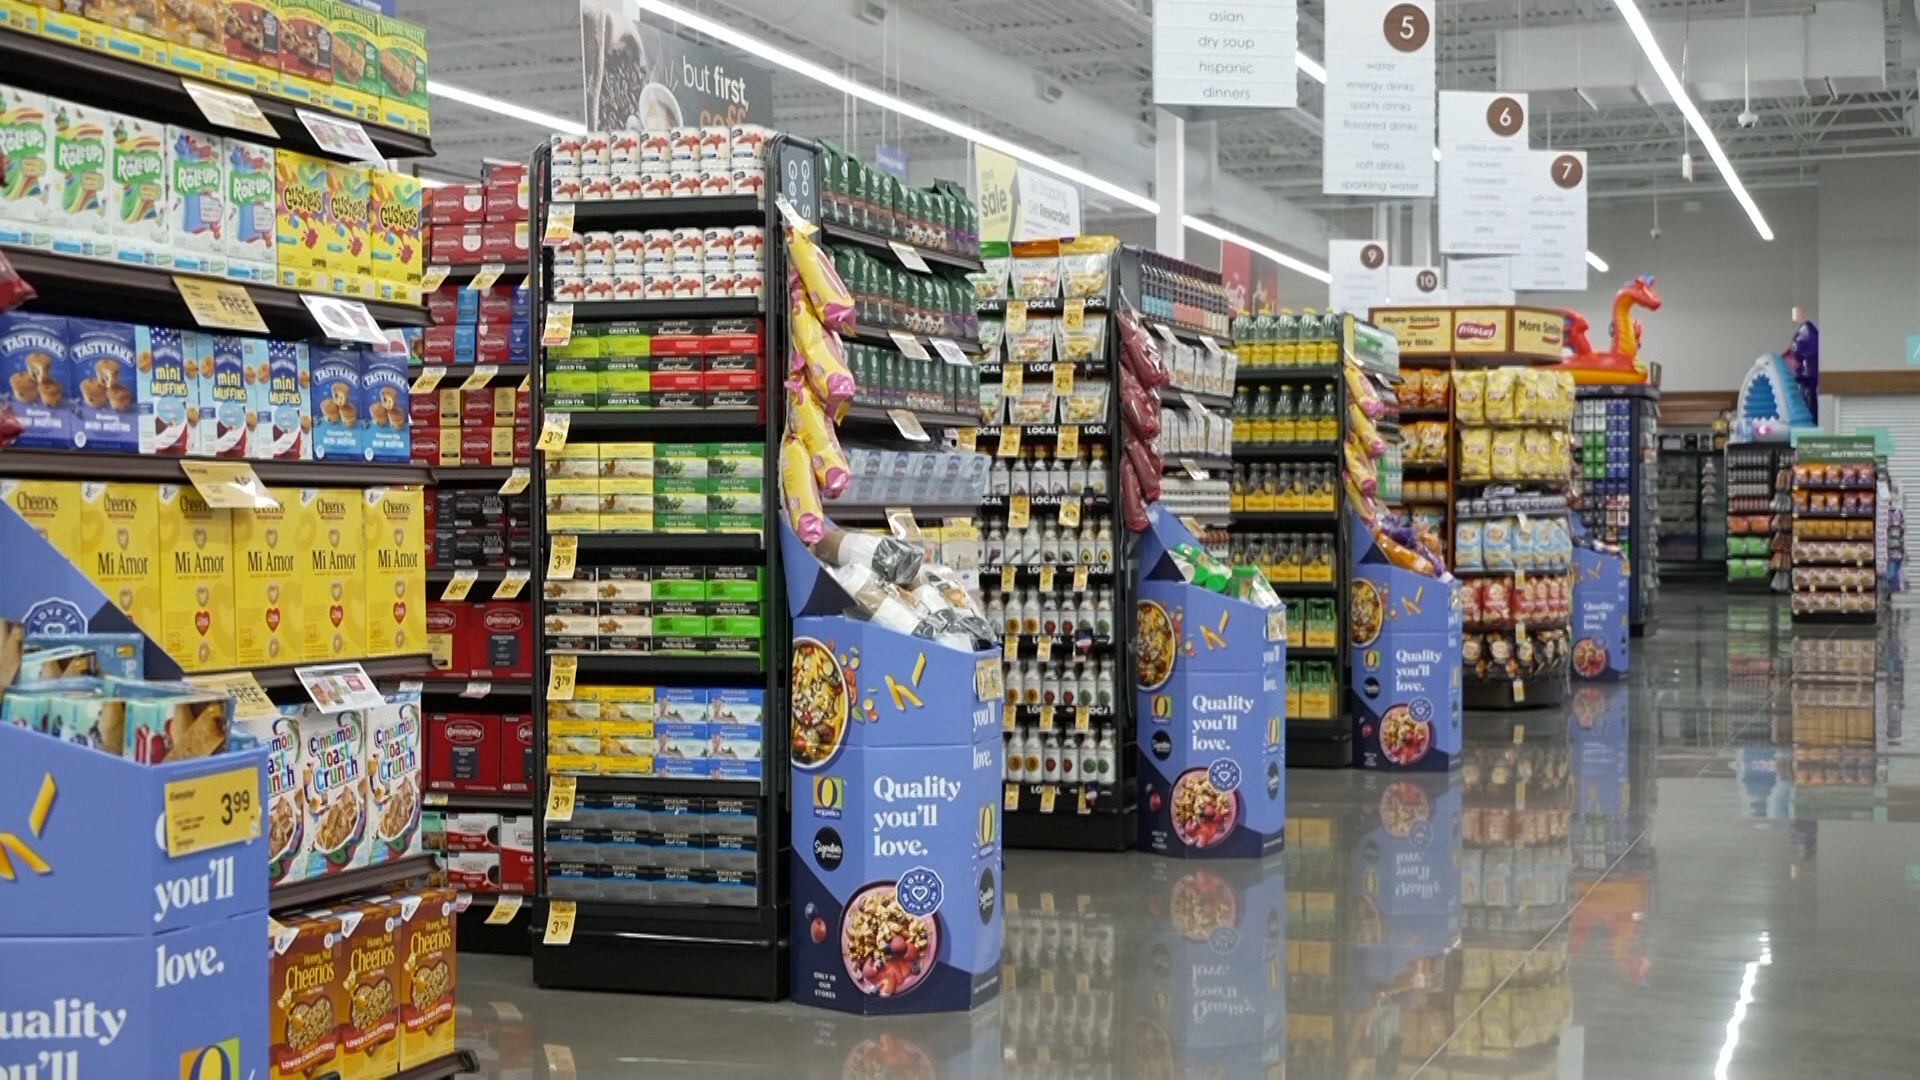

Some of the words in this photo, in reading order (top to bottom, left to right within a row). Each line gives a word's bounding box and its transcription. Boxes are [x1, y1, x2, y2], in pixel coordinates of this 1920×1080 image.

[1209, 10, 1244, 22] asian
[1400, 15, 1415, 40] 5
[1198, 36, 1219, 49] dry
[1223, 38, 1255, 49] soup
[1199, 62, 1254, 75] hispanic
[1366, 62, 1396, 70] water
[682, 55, 711, 95] but
[713, 65, 750, 112] first,
[1347, 82, 1383, 92] energy
[1386, 81, 1414, 92] drinks
[1203, 87, 1250, 99] dinners
[1350, 101, 1380, 112] sports
[1382, 101, 1411, 112] drinks
[1500, 107, 1512, 127] 6
[1343, 120, 1387, 131] flavored
[1389, 121, 1418, 132] drinks
[1371, 141, 1390, 150] tea
[1355, 160, 1374, 170] soft
[1376, 160, 1406, 170] drinks
[1562, 163, 1573, 180] 7
[1341, 180, 1387, 191] sparkling
[1389, 181, 1419, 191] water
[980, 183, 1007, 218] sale
[1368, 249, 1378, 264] 9
[1420, 275, 1434, 288] 10
[1382, 315, 1407, 324] More
[1409, 315, 1440, 324] Smiles
[1518, 319, 1541, 334] More
[156, 364, 181, 381] mini
[217, 370, 241, 386] mini
[273, 376, 295, 392] mini
[545, 431, 564, 445] 379
[1027, 426, 1058, 435] LOCAL
[98, 552, 115, 576] Mi
[118, 553, 149, 576] Amor
[175, 551, 191, 574] Mi
[194, 552, 225, 574] Amor
[248, 551, 263, 572] Mi
[265, 552, 294, 572] Amor
[312, 550, 326, 570] Mi
[328, 550, 356, 570] Amor
[378, 550, 392, 568] Mi
[394, 550, 418, 568] Amor
[554, 556, 571, 570] 379
[33, 608, 62, 627] LOVE
[64, 611, 78, 627] IT
[1396, 649, 1442, 664] Quality
[1396, 665, 1430, 682] you'll
[554, 675, 571, 690] 379
[1396, 681, 1425, 692] love.
[1192, 694, 1254, 714] Quality
[973, 701, 996, 734] you'll
[1192, 714, 1237, 734] you'll
[376, 717, 416, 744] Cinnamon
[309, 723, 357, 757] Cinnamon
[1192, 735, 1231, 751] love.
[973, 746, 993, 770] love.
[873, 775, 961, 802] Quality
[552, 795, 569, 811] 379
[873, 803, 938, 832] you'll
[873, 835, 929, 856] love.
[154, 856, 234, 922] you'll
[904, 874, 926, 890] LOVE
[550, 921, 569, 936] 379
[411, 929, 451, 955] Cheerios
[156, 943, 225, 988] love.
[350, 946, 395, 974] Cheerios
[286, 962, 334, 992] Cheerios
[0, 997, 127, 1046] uality
